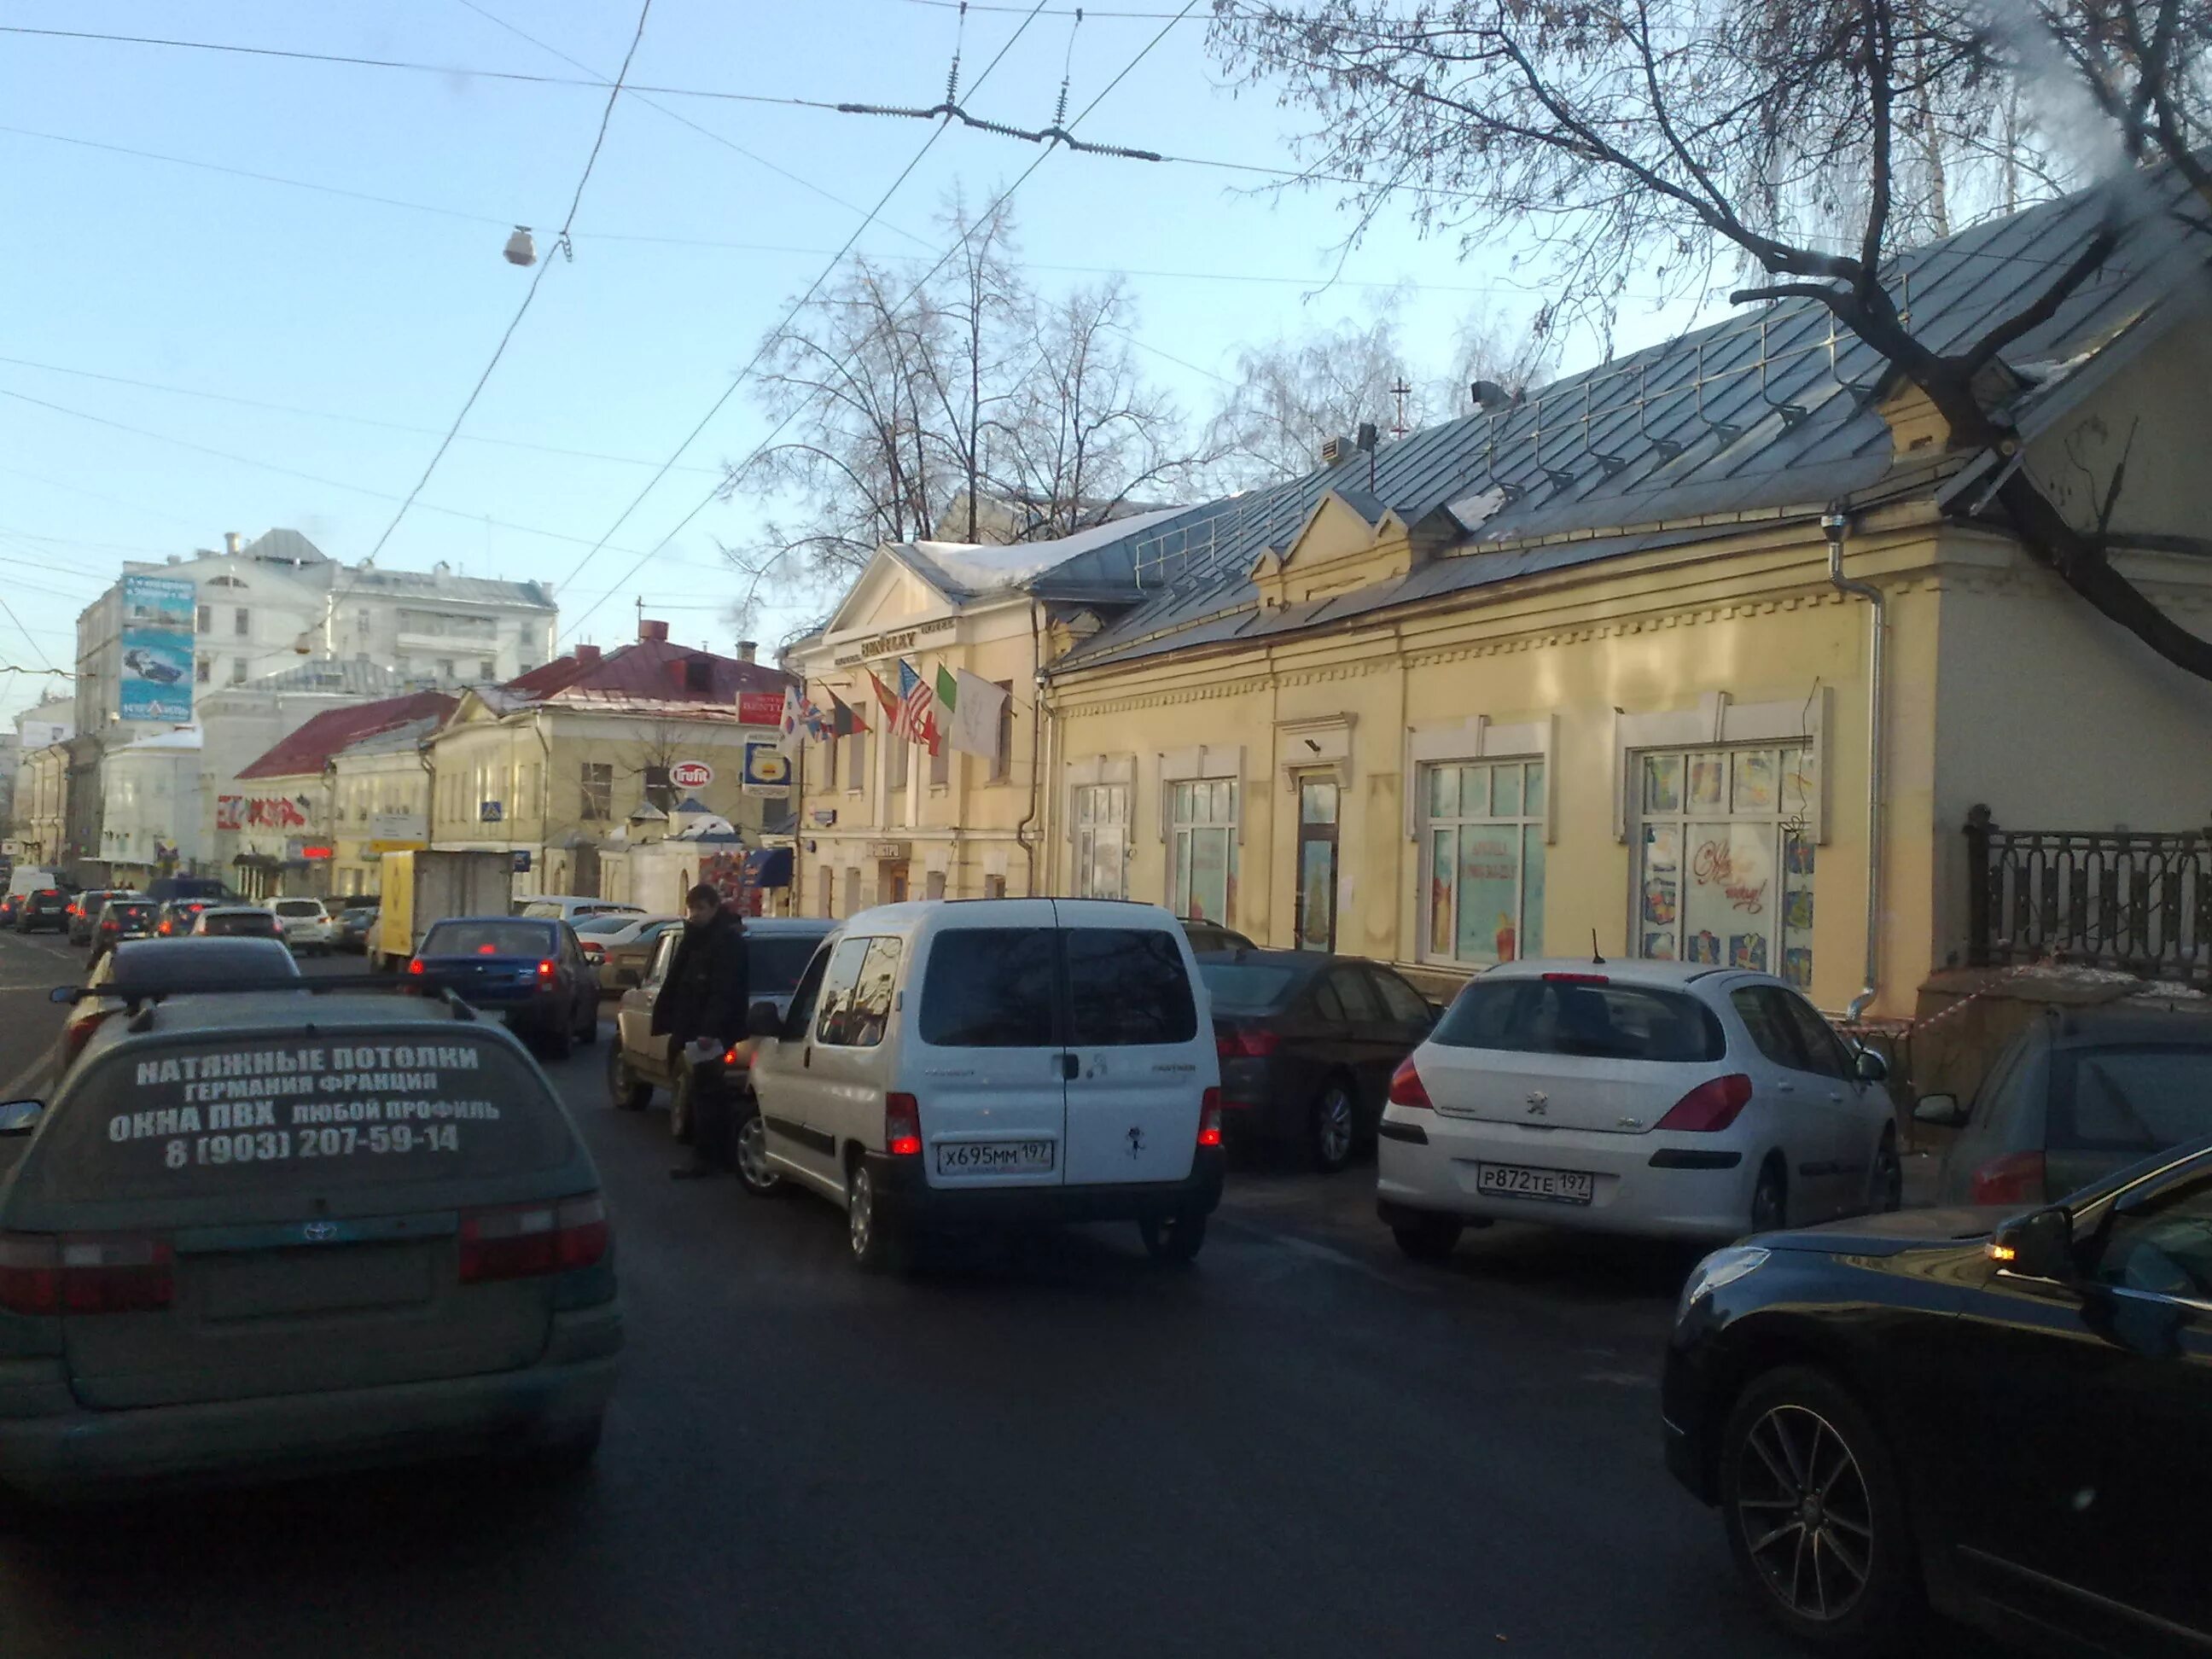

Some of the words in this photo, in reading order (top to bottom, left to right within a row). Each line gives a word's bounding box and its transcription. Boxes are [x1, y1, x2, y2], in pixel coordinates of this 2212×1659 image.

[742, 701, 782, 712] BENTL
[137, 1049, 325, 1086] НАТЯЖНЫЕ
[332, 1046, 479, 1070] ПОТОЛКИ
[184, 1075, 313, 1102] ГЕРМАНИЯ
[318, 1073, 437, 1093] ФРАНЦИЯ
[108, 1109, 201, 1142] ОКНА
[209, 1101, 276, 1129] ПВХ
[292, 1098, 381, 1124] ЛЮБОЙ
[386, 1101, 500, 1121] ПРОФИЛЬ
[165, 1140, 187, 1168] 8
[299, 1124, 460, 1157] 207-59-14
[1022, 1144, 1046, 1158] 197
[1559, 1173, 1585, 1190] 197
